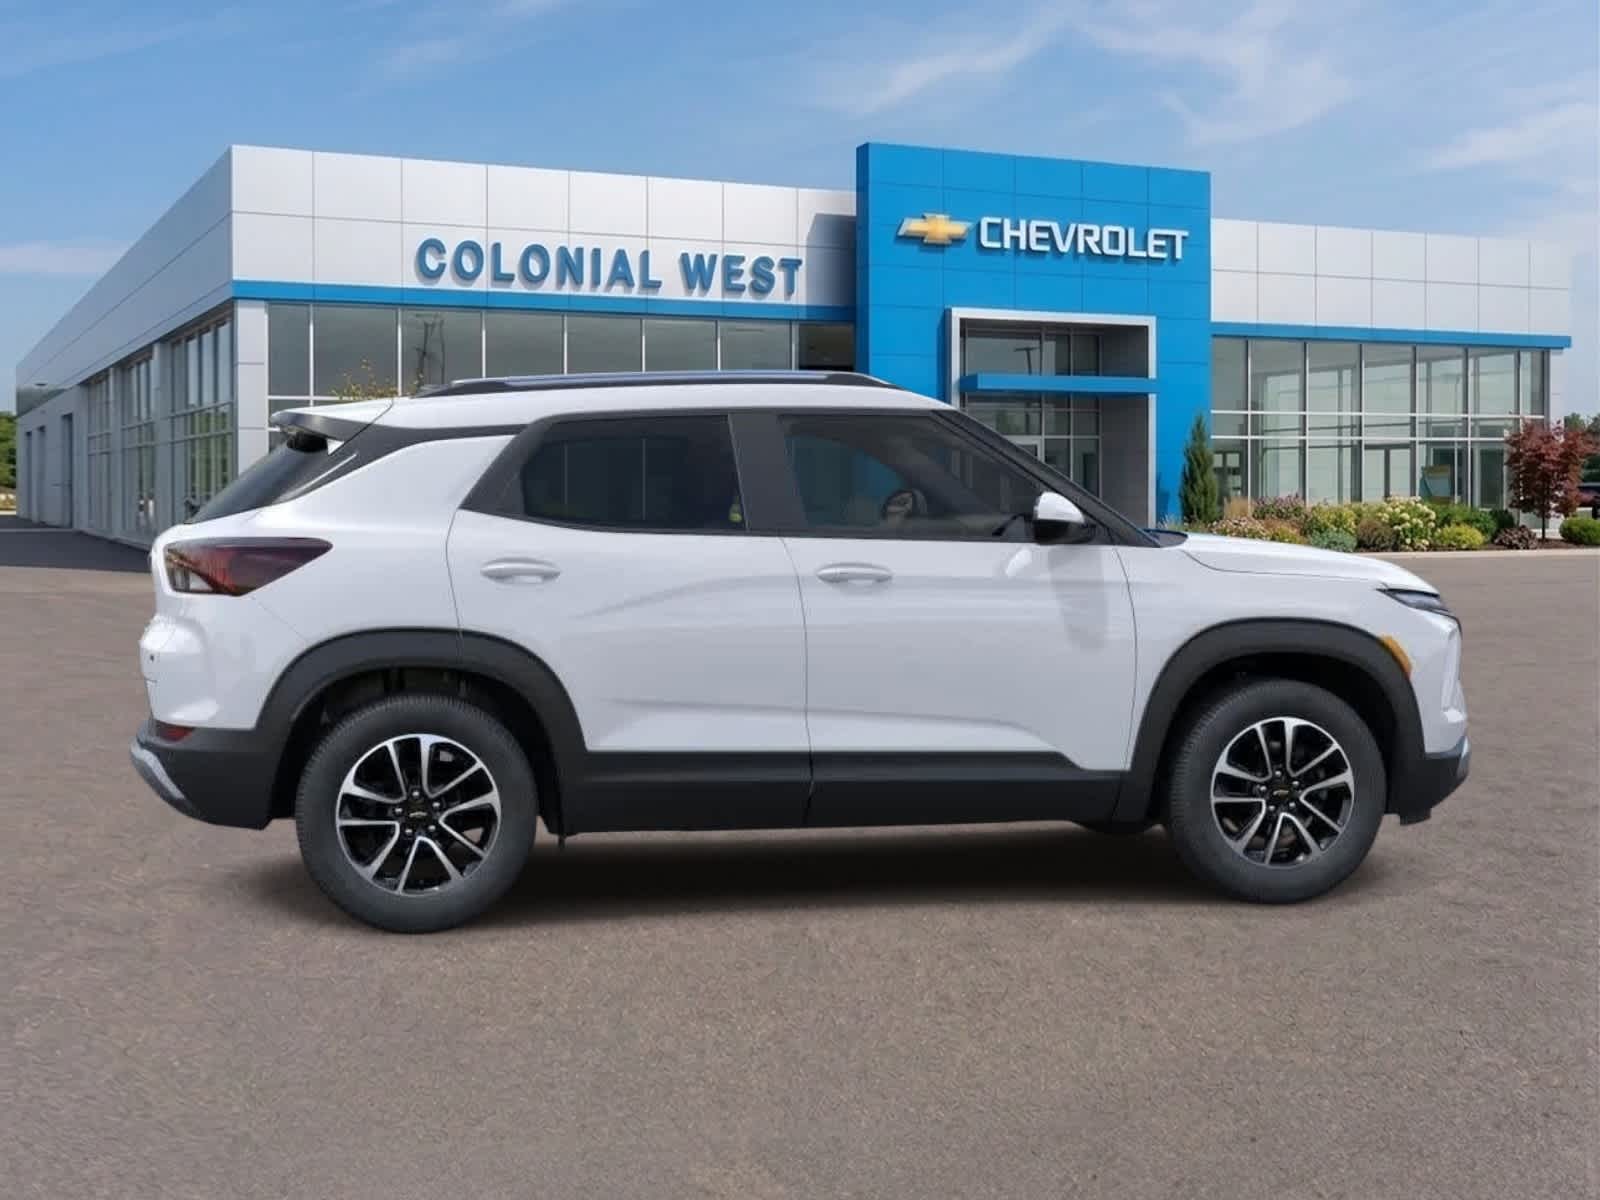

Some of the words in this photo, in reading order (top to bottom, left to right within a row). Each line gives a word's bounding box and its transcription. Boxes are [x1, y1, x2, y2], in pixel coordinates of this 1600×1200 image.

[979, 216, 1189, 261] CHEVROLET
[415, 238, 662, 289] COLONIAL
[680, 252, 803, 297] WEST
